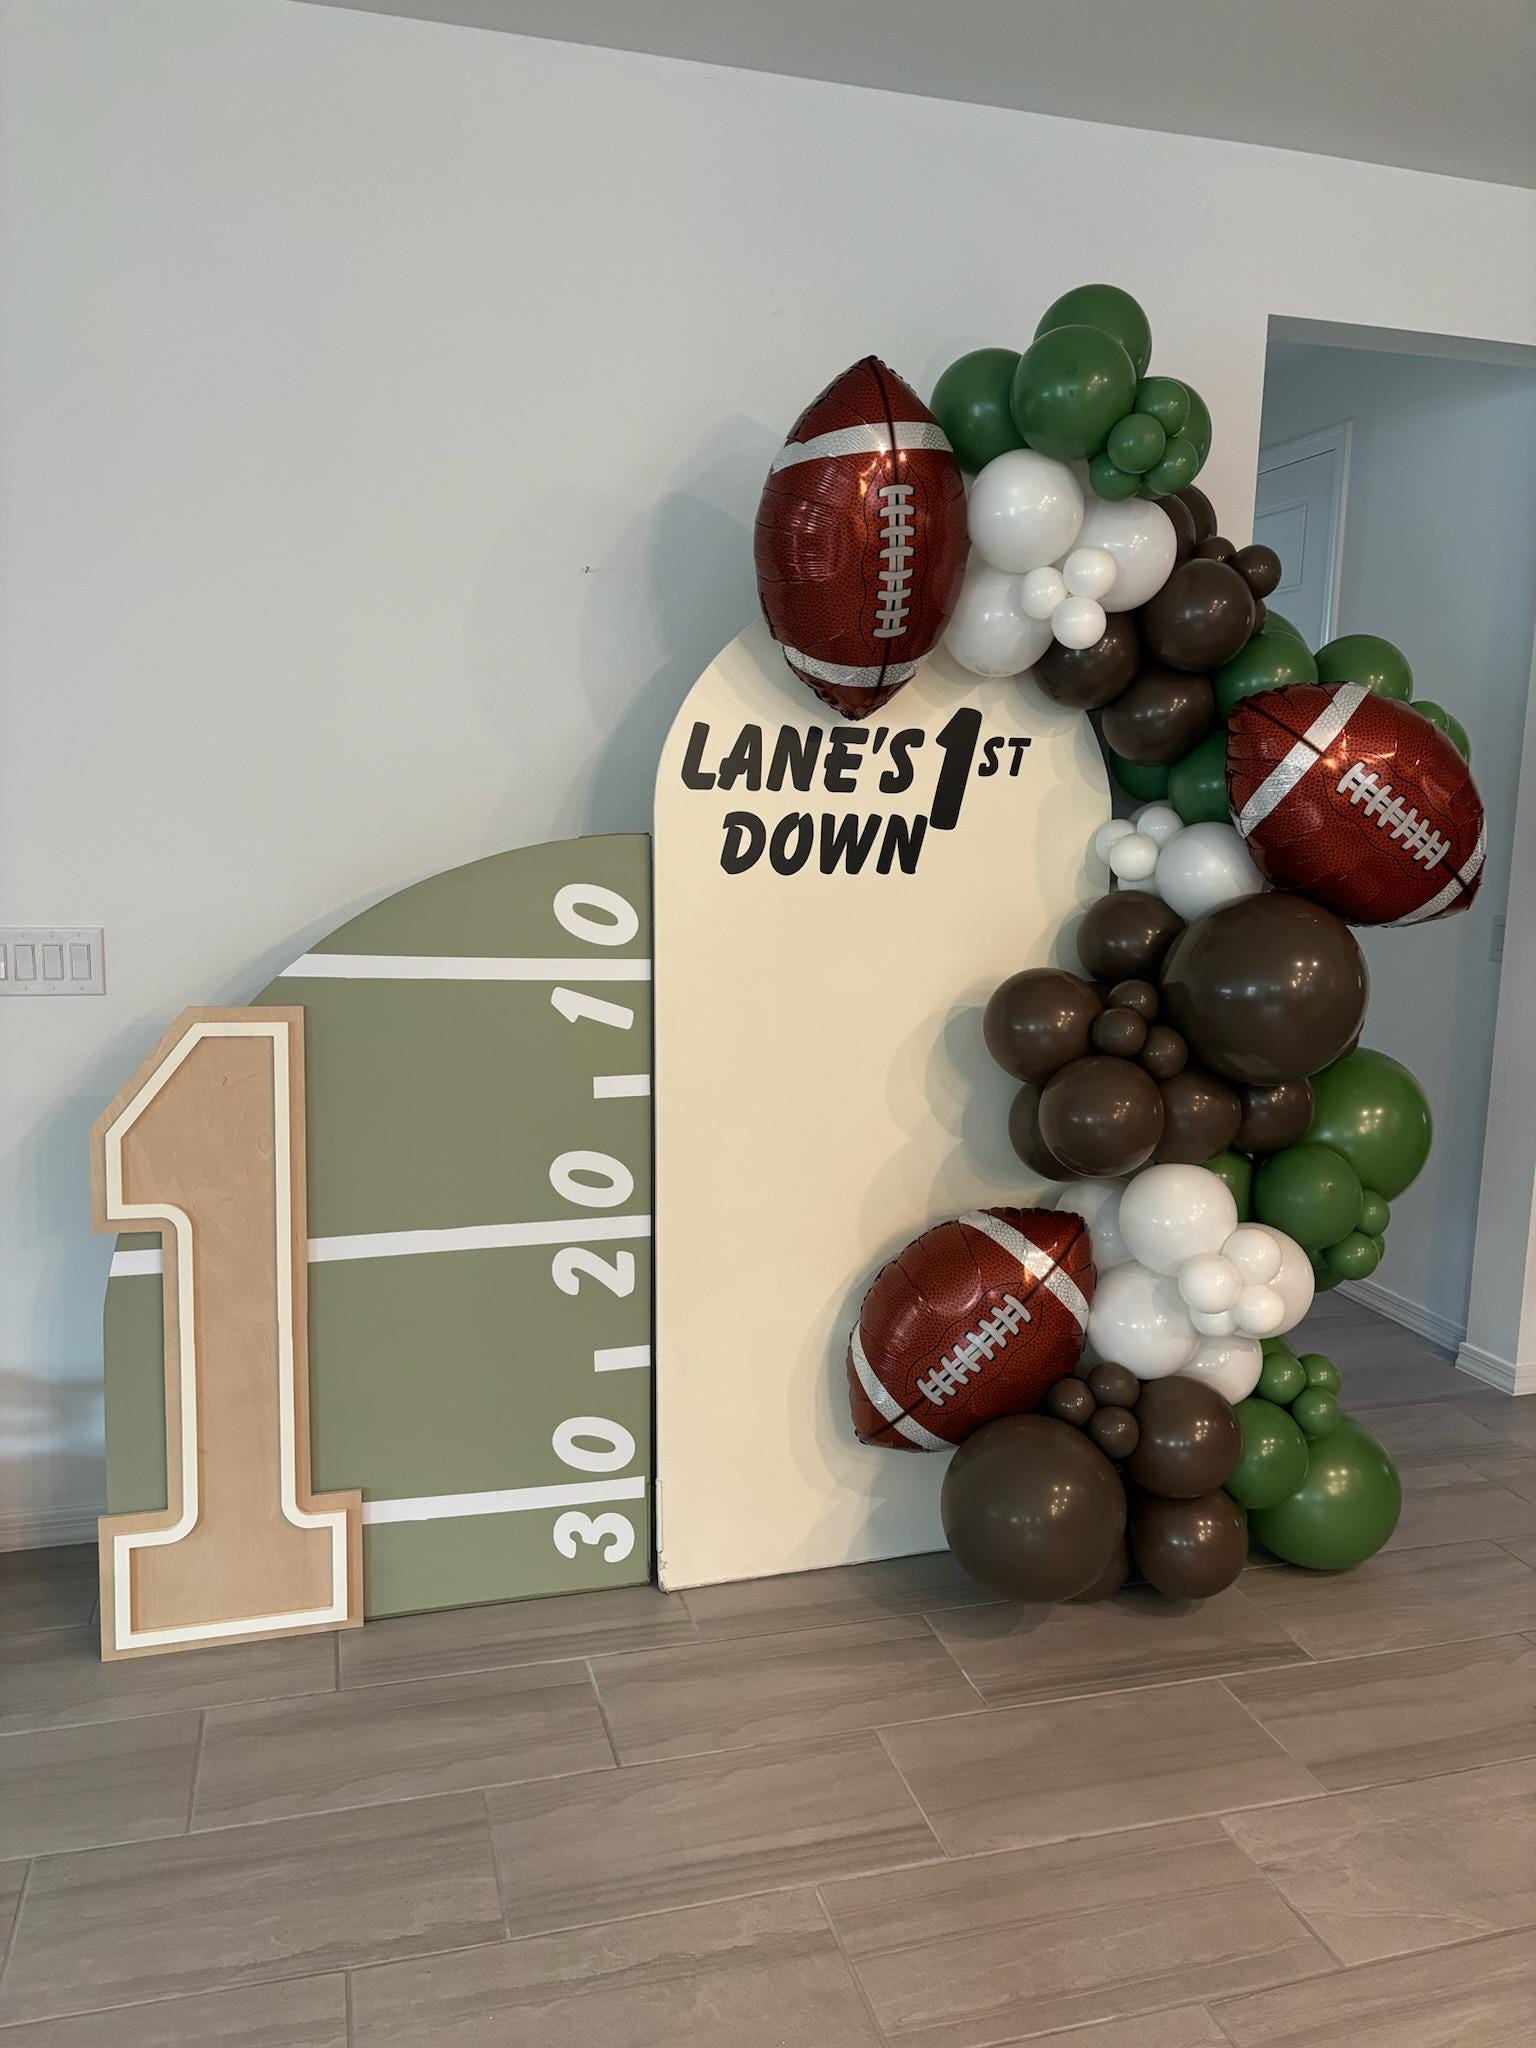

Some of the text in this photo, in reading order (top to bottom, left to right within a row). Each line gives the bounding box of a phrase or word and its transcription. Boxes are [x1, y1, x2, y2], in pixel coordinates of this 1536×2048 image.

[681, 707, 1032, 831] LANE'S 1ST
[720, 811, 928, 876] DOWN
[550, 883, 640, 1031] 10
[549, 1150, 636, 1299] 20
[89, 1005, 364, 1662] 1
[551, 1415, 637, 1564] 30
